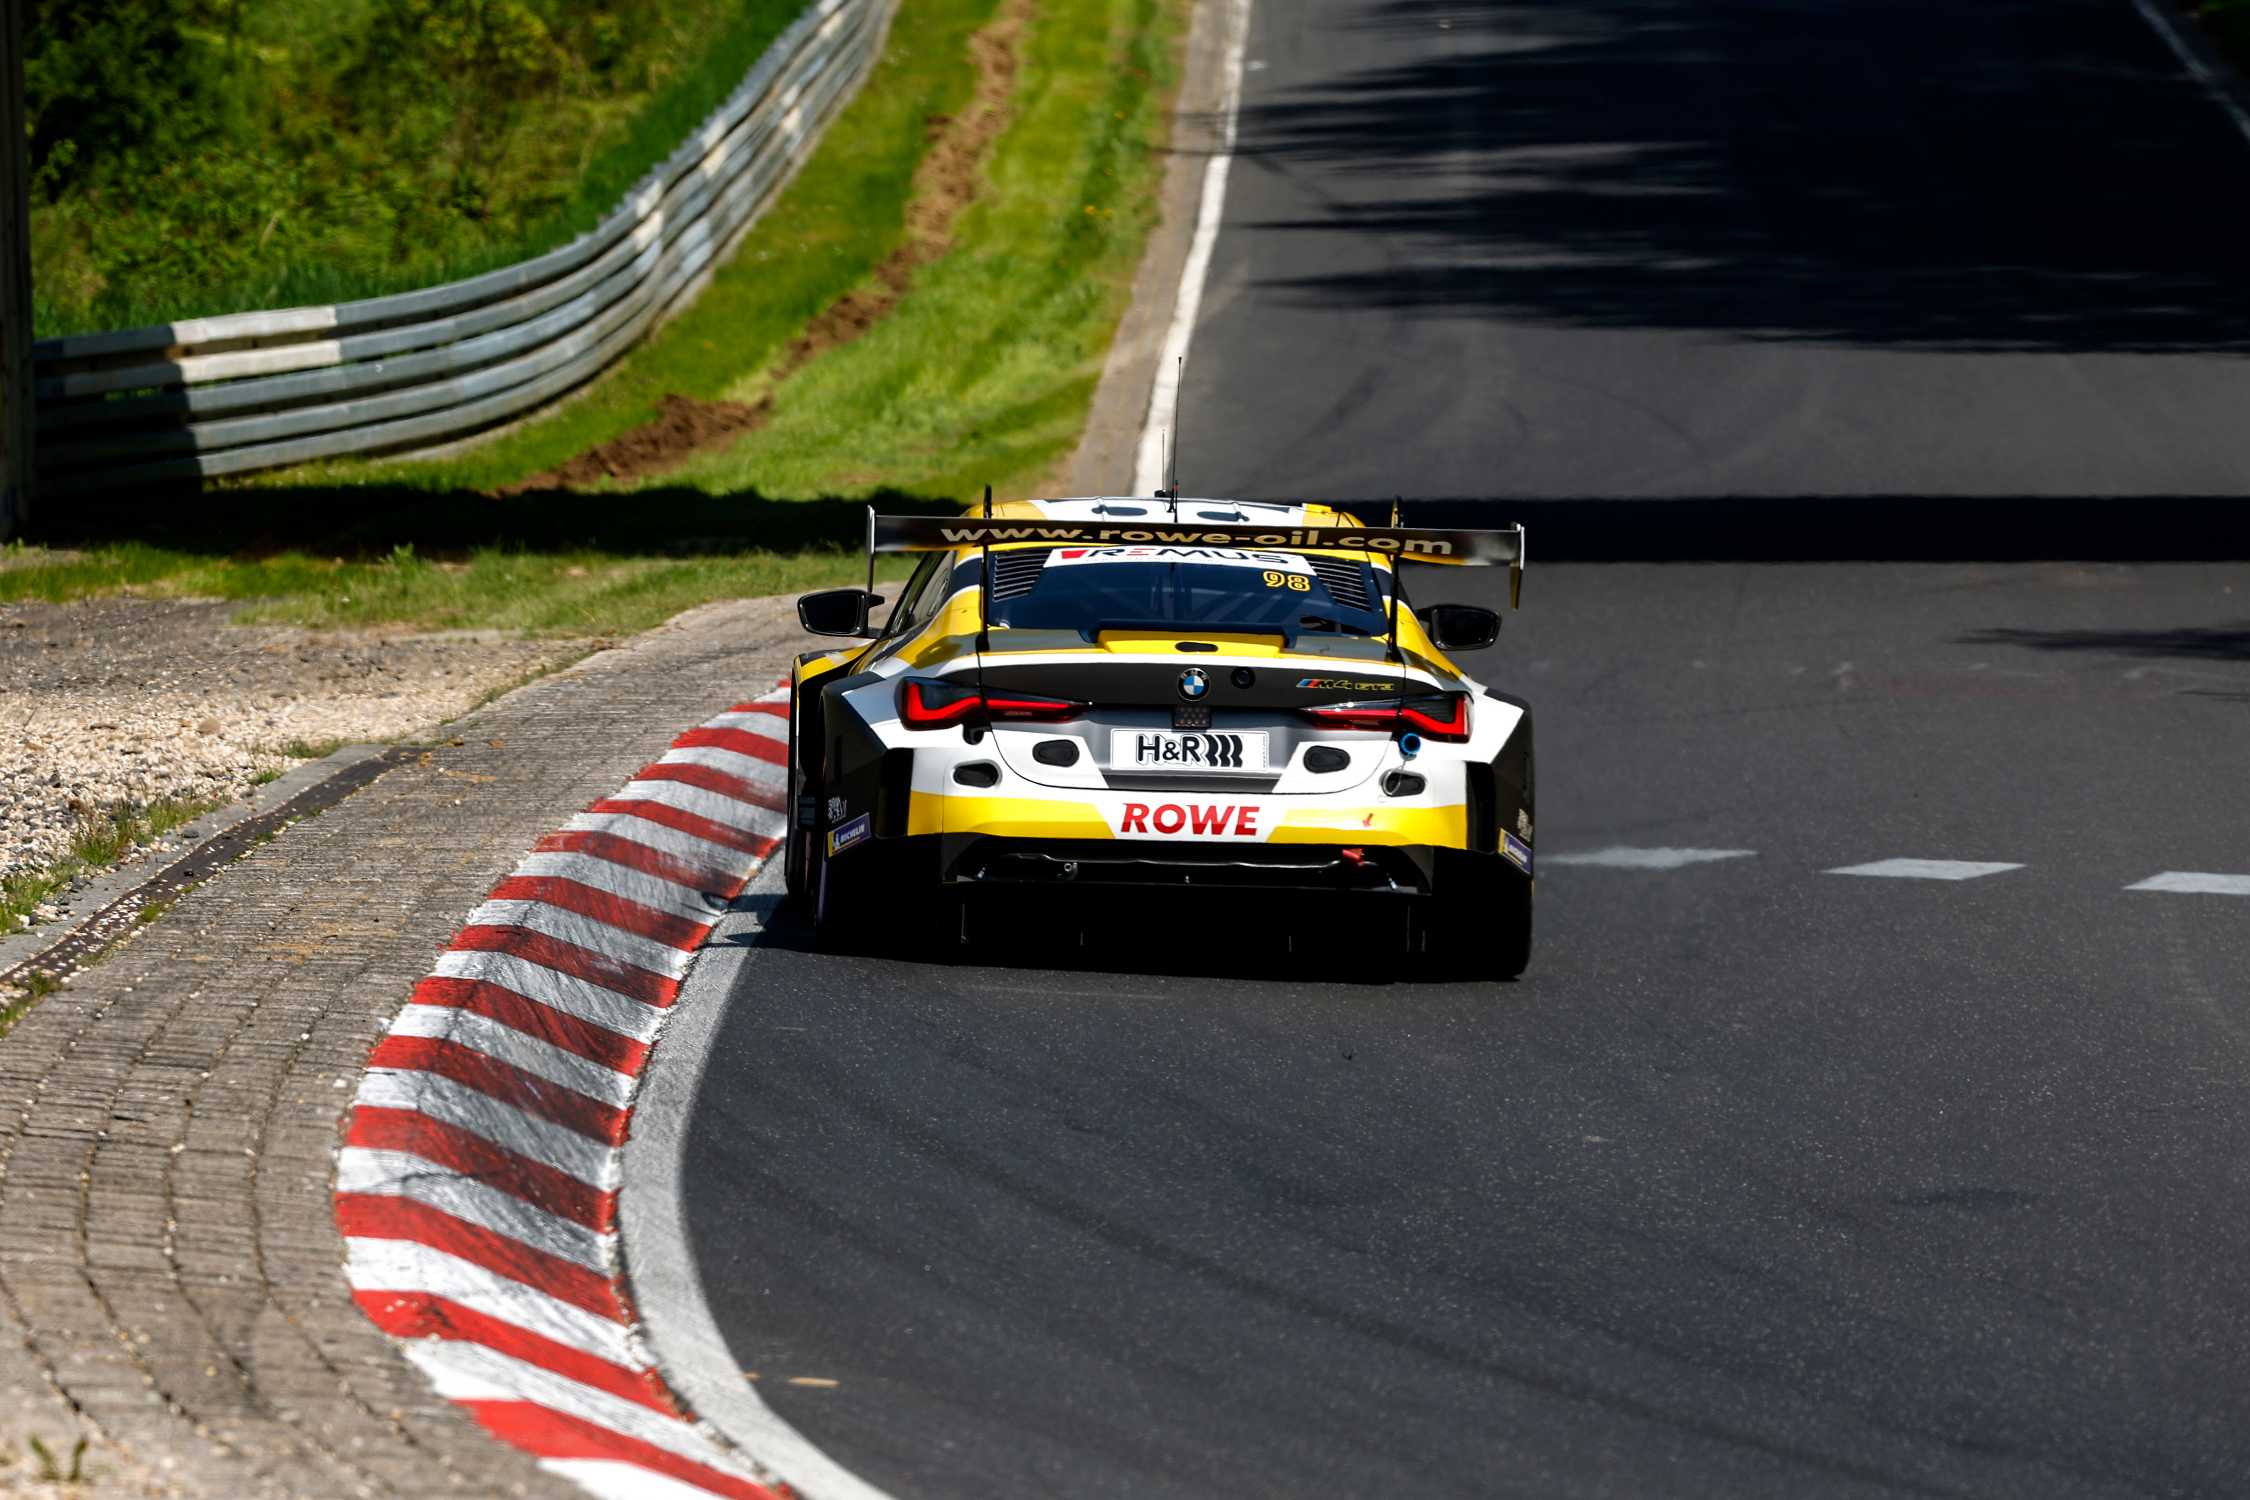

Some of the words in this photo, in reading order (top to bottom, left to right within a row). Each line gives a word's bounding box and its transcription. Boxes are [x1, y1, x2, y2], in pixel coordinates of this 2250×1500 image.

[941, 528, 1453, 554] www.rowe-oil.com
[1088, 548, 1288, 564] REMUS
[1263, 570, 1311, 592] 98
[1311, 679, 1352, 690] M4
[1137, 735, 1202, 763] H&R
[1121, 802, 1260, 836] ROWE
